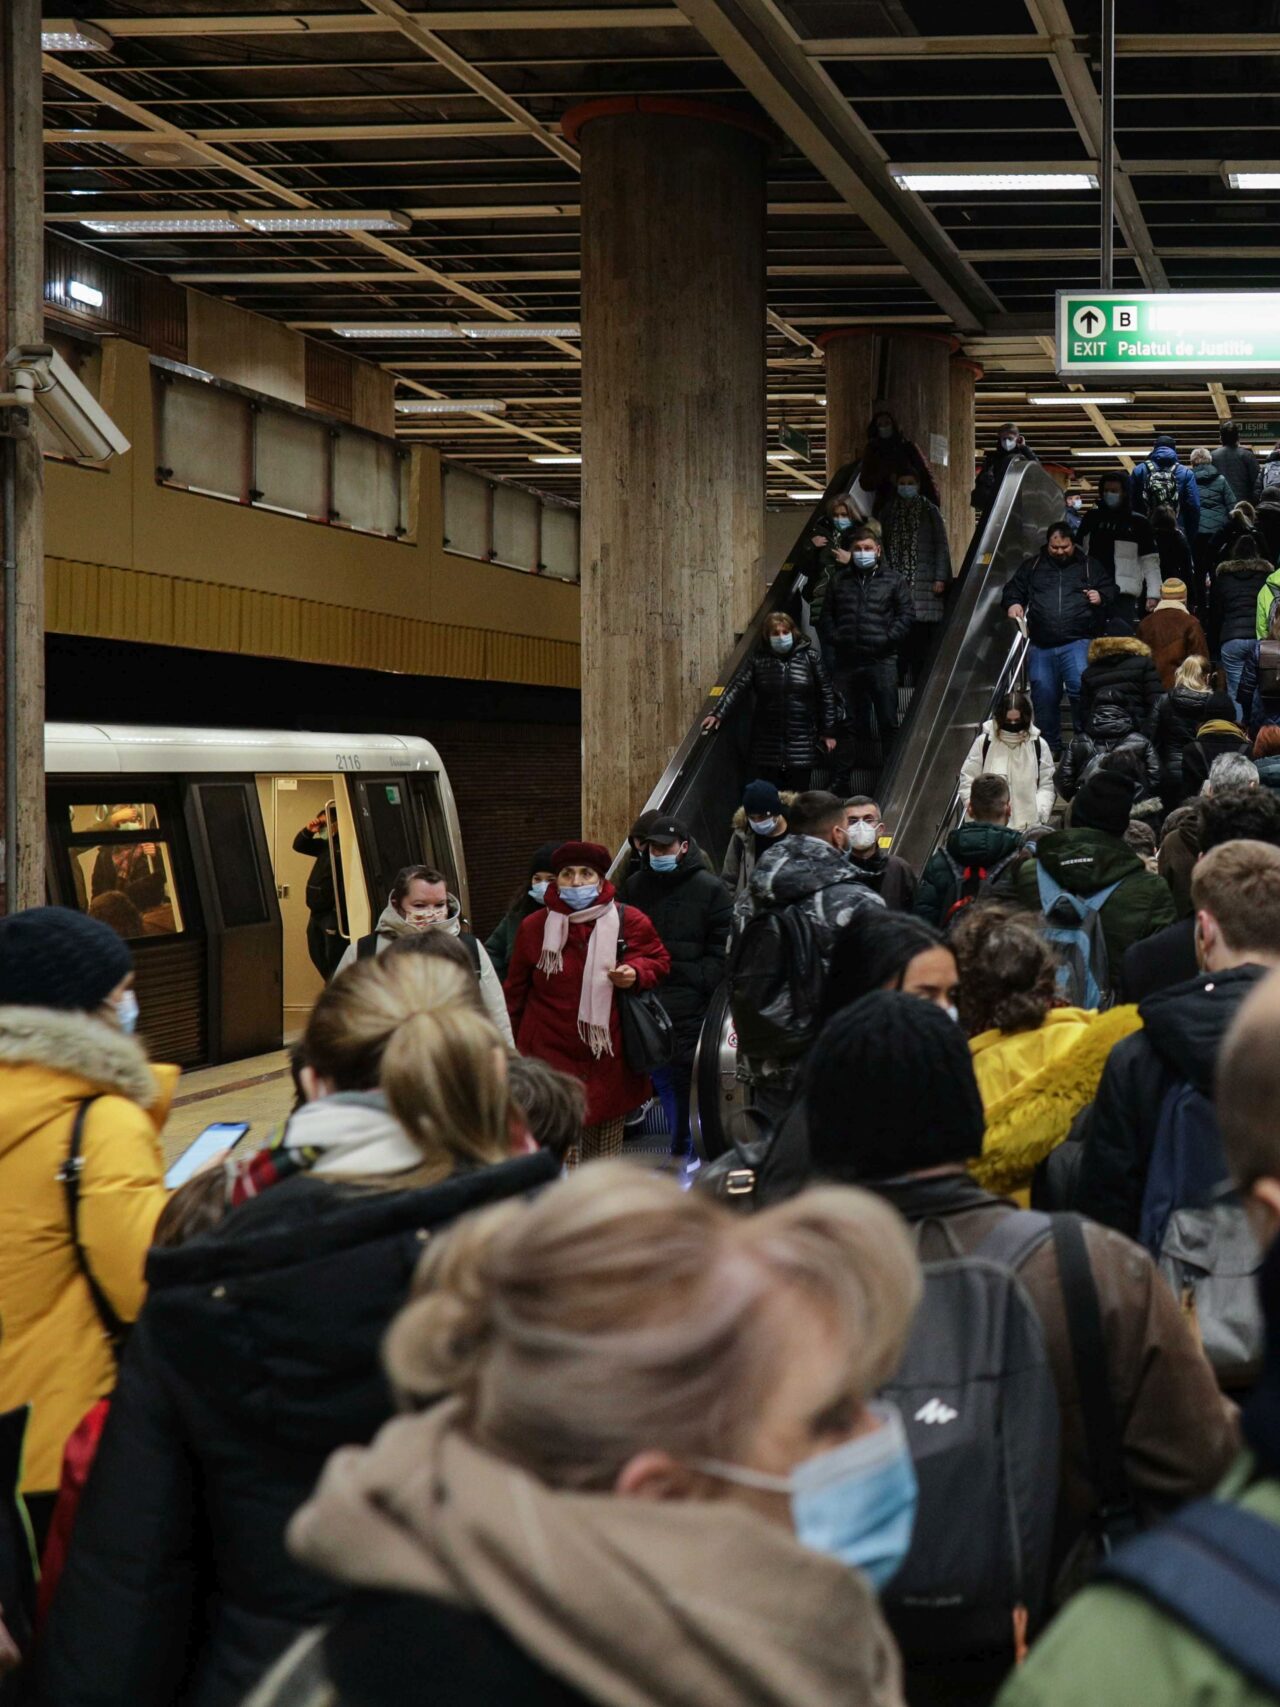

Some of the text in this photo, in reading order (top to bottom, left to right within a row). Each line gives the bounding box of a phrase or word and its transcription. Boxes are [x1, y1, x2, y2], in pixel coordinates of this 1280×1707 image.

[1119, 312, 1131, 327] B
[1073, 341, 1107, 356] EXIT
[1117, 341, 1171, 356] Palatul
[1175, 341, 1193, 356] de
[336, 754, 361, 770] 2116
